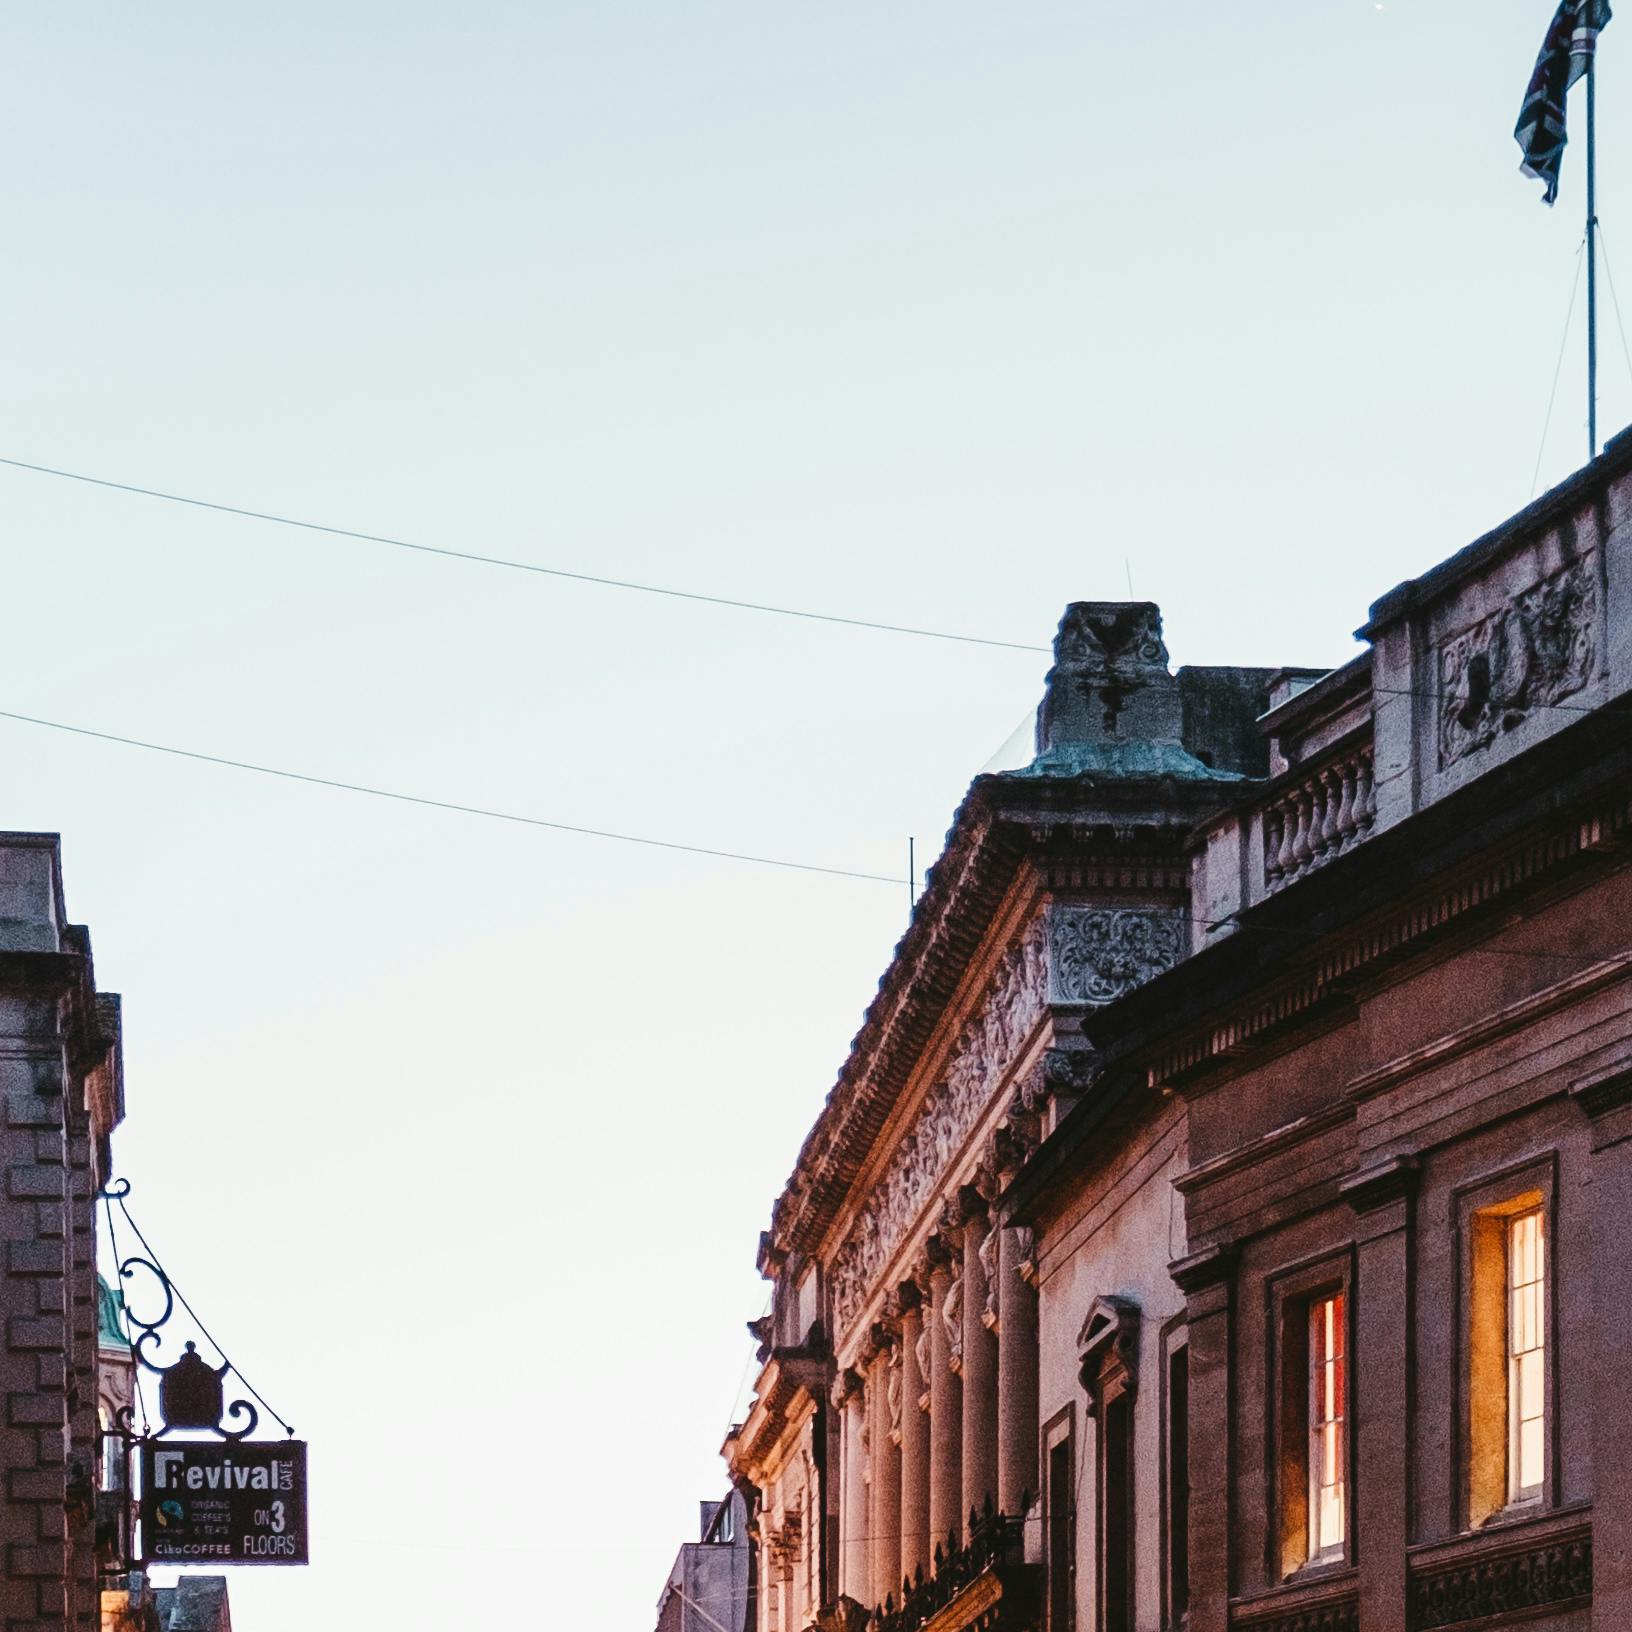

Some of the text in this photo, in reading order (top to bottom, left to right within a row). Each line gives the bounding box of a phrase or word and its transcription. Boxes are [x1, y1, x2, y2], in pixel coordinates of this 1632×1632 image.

[154, 1451, 279, 1489] Revival
[271, 1501, 285, 1533] 3
[243, 1535, 295, 1555] FLOORS
